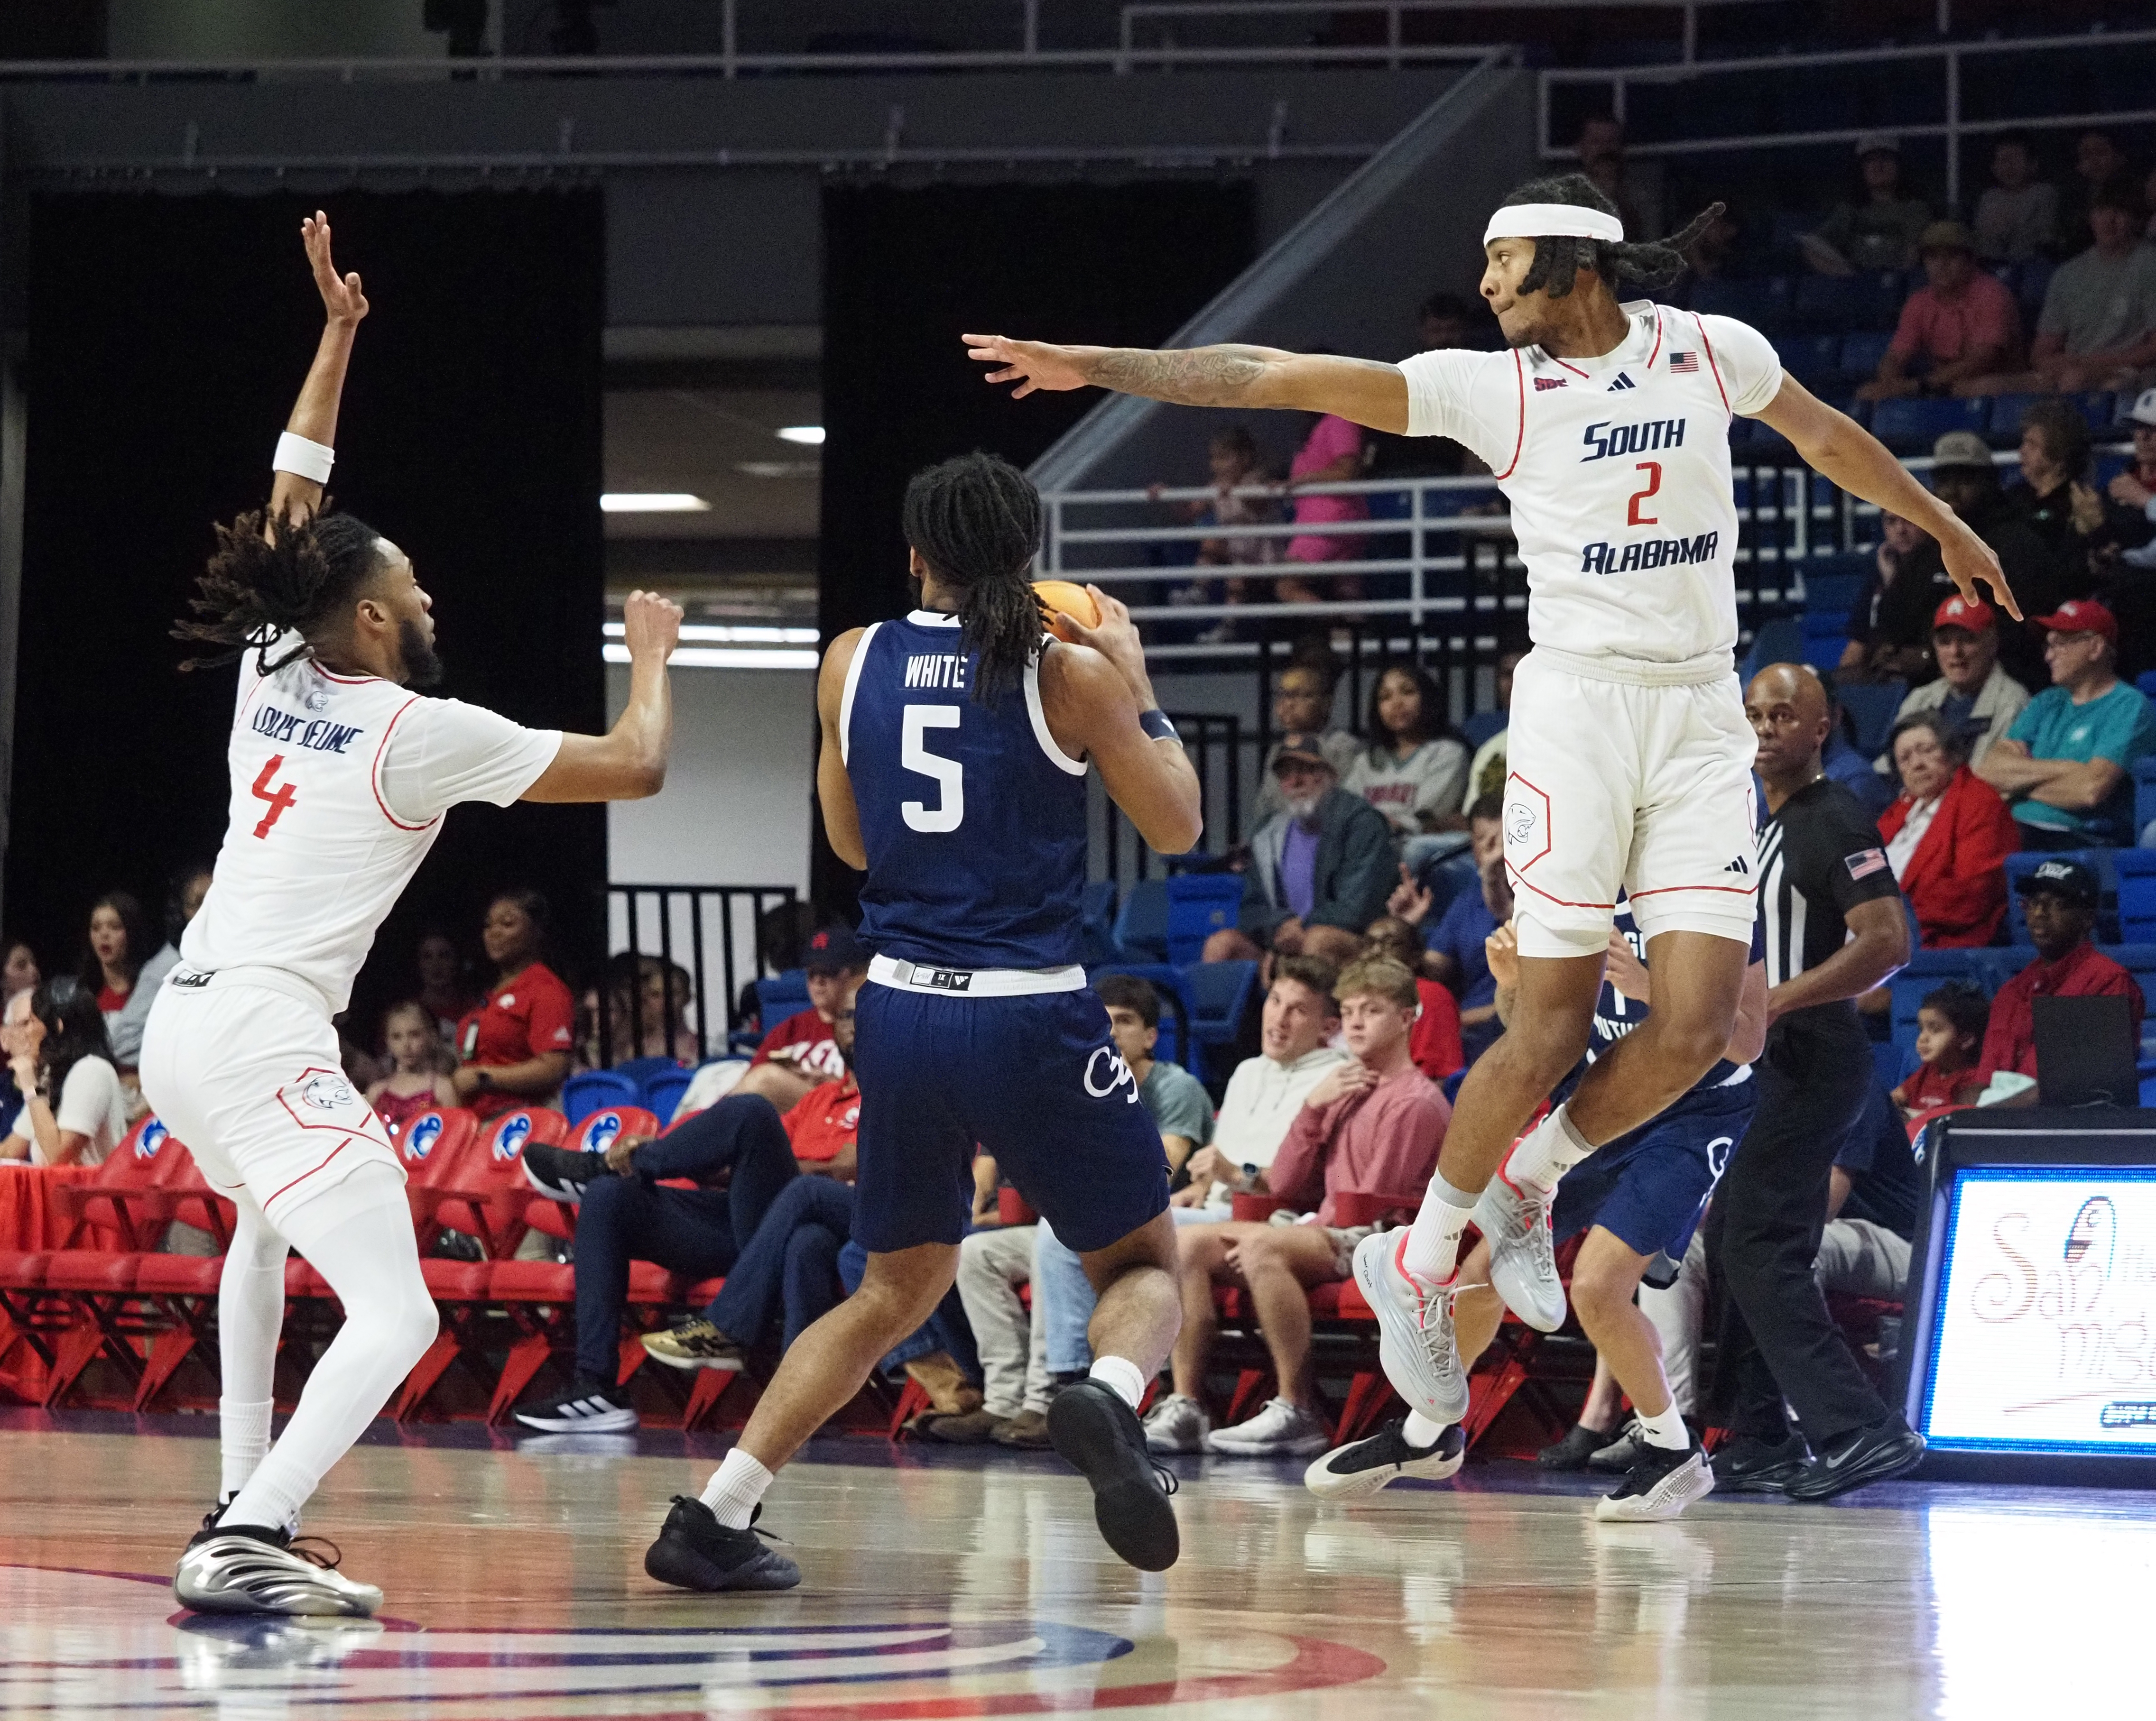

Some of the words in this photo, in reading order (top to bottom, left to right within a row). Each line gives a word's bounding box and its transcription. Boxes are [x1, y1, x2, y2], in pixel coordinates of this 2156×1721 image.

[1579, 418, 1685, 462] SOUTH
[1627, 461, 1662, 526] 2
[1581, 531, 1718, 575] ALABAMA
[905, 655, 968, 688] WHITE
[252, 703, 306, 742] LOUIS
[902, 705, 963, 833] 5
[251, 754, 297, 839] 4
